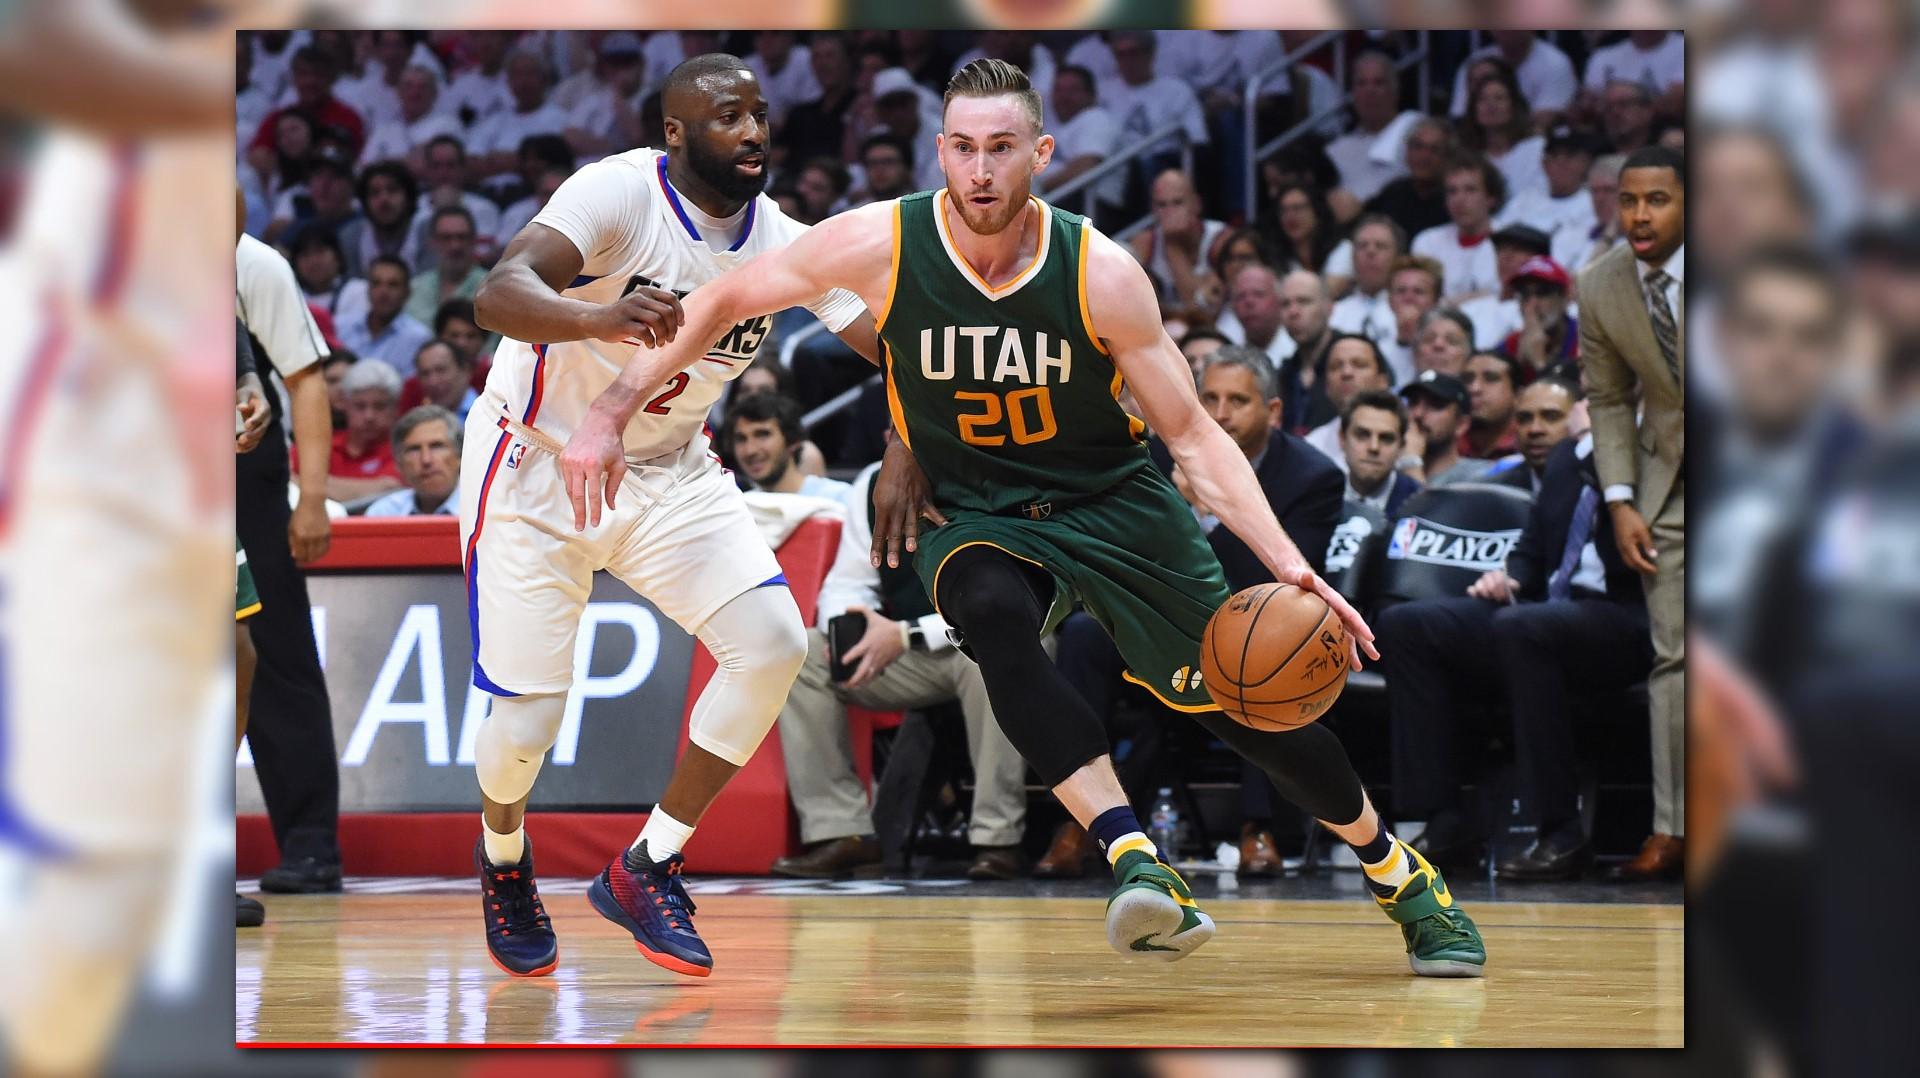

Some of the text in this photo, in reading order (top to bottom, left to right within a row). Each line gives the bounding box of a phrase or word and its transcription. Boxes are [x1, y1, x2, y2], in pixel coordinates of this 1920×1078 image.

[920, 325, 1072, 386] UTAH
[643, 371, 690, 415] 2
[953, 386, 1058, 447] 20
